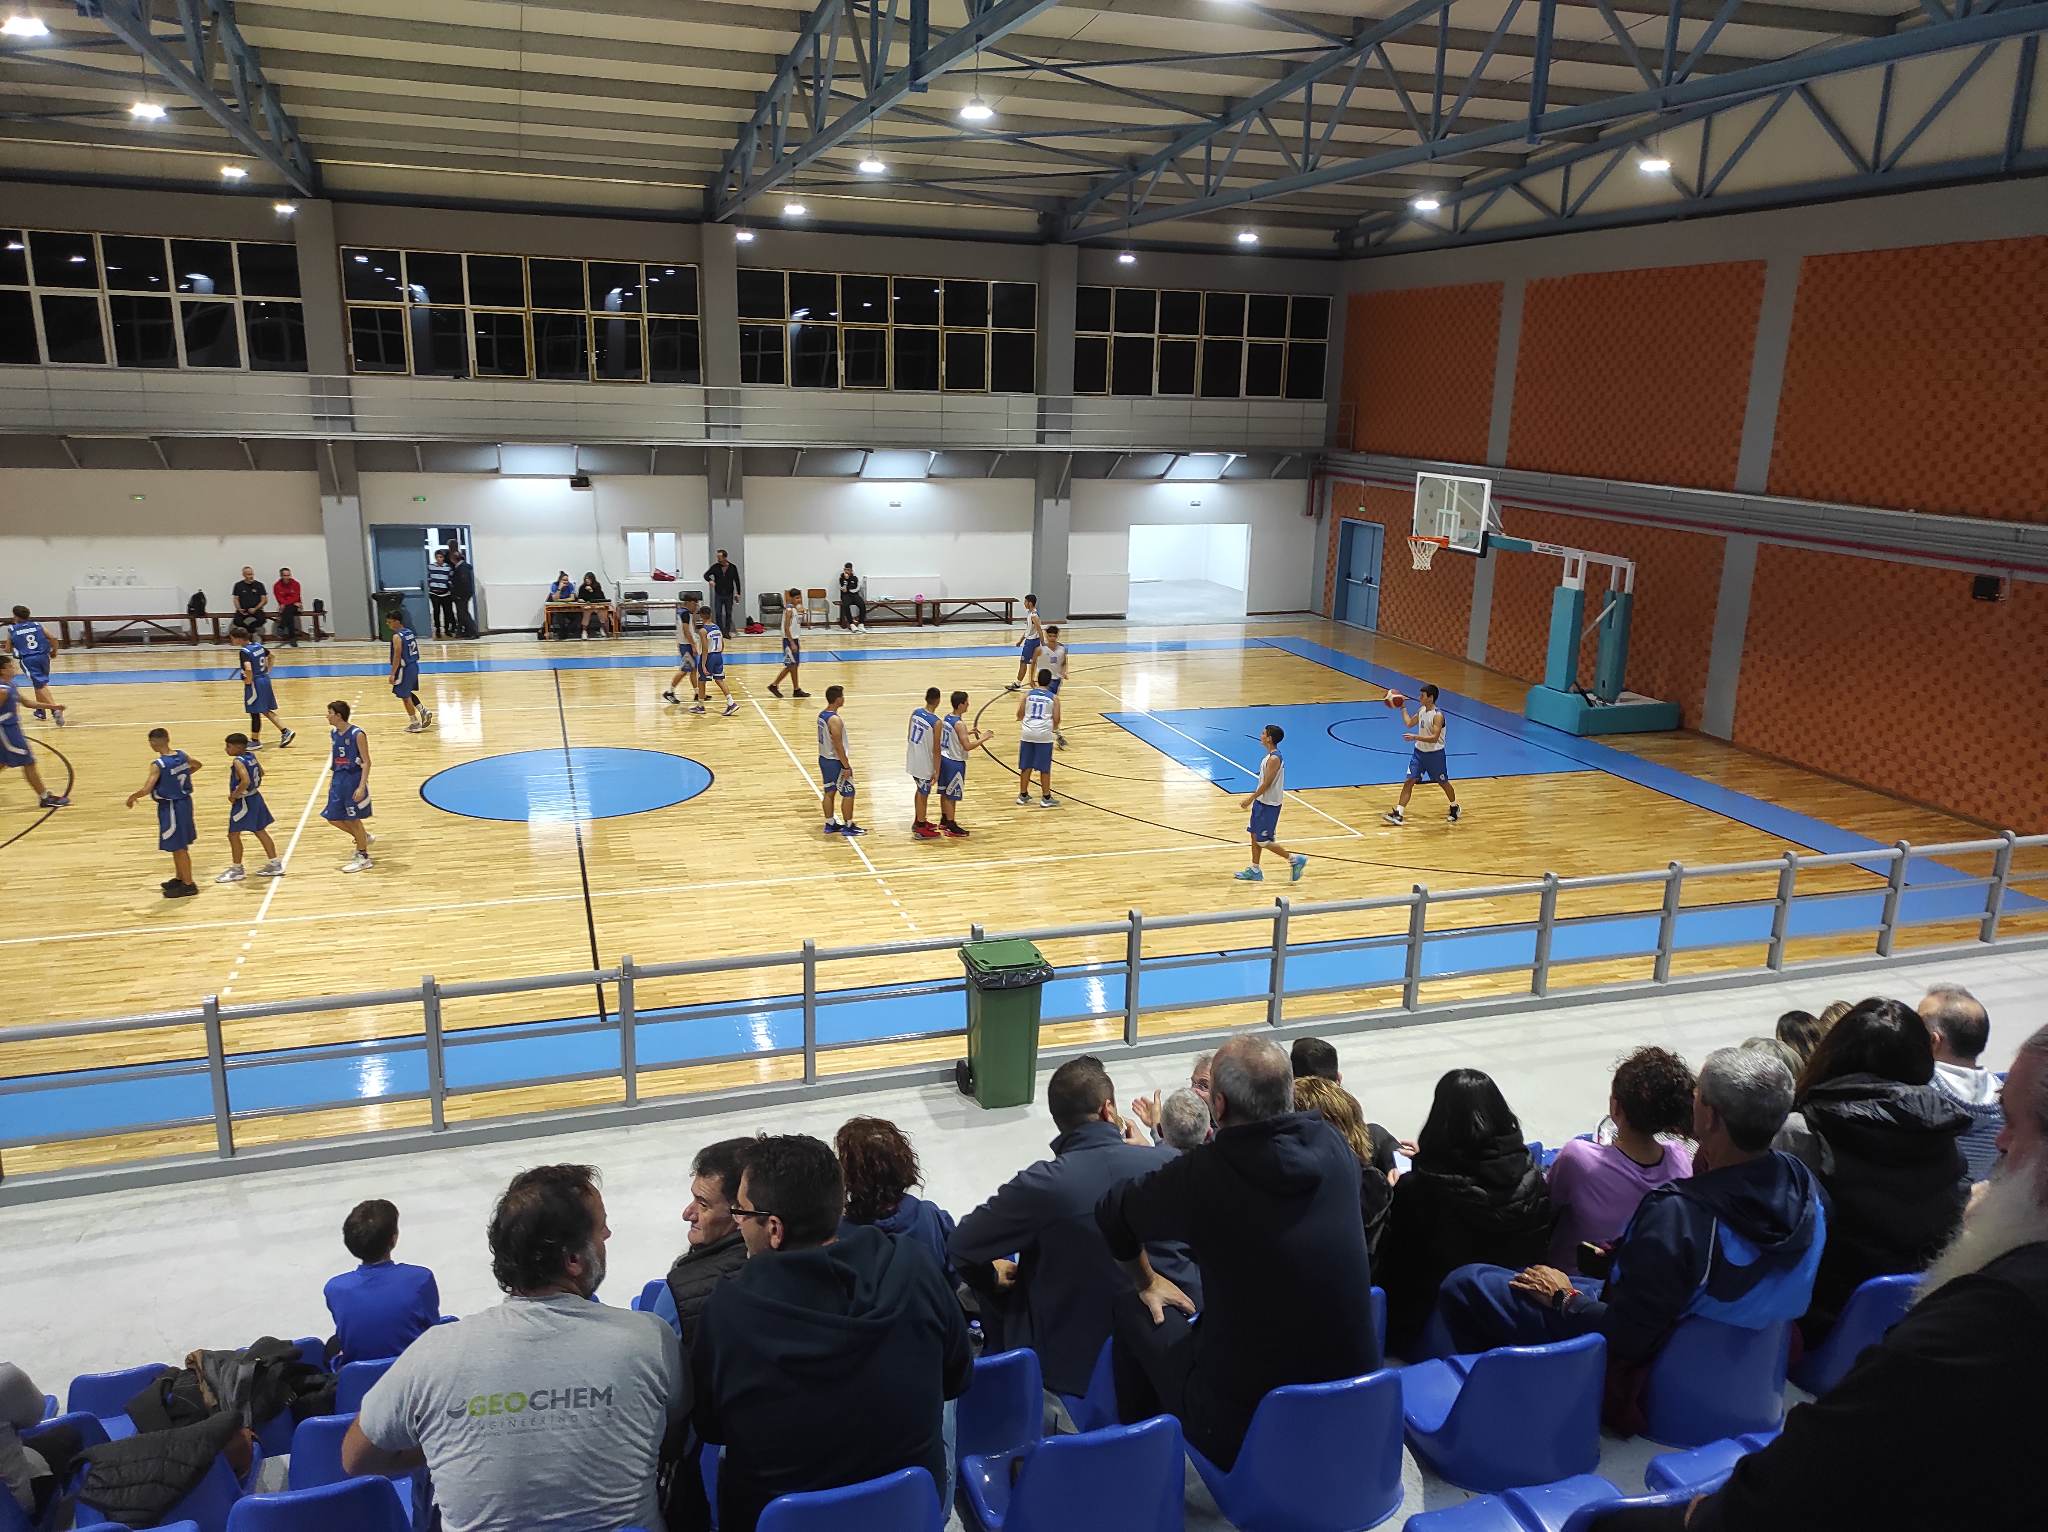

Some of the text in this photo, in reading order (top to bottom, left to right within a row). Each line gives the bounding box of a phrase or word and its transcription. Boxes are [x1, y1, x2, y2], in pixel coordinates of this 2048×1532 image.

[26, 634, 38, 650] 8
[712, 637, 719, 651] 7
[1030, 702, 1044, 720] 11
[910, 723, 924, 745] 17
[468, 1384, 613, 1417] GEOCHEM
